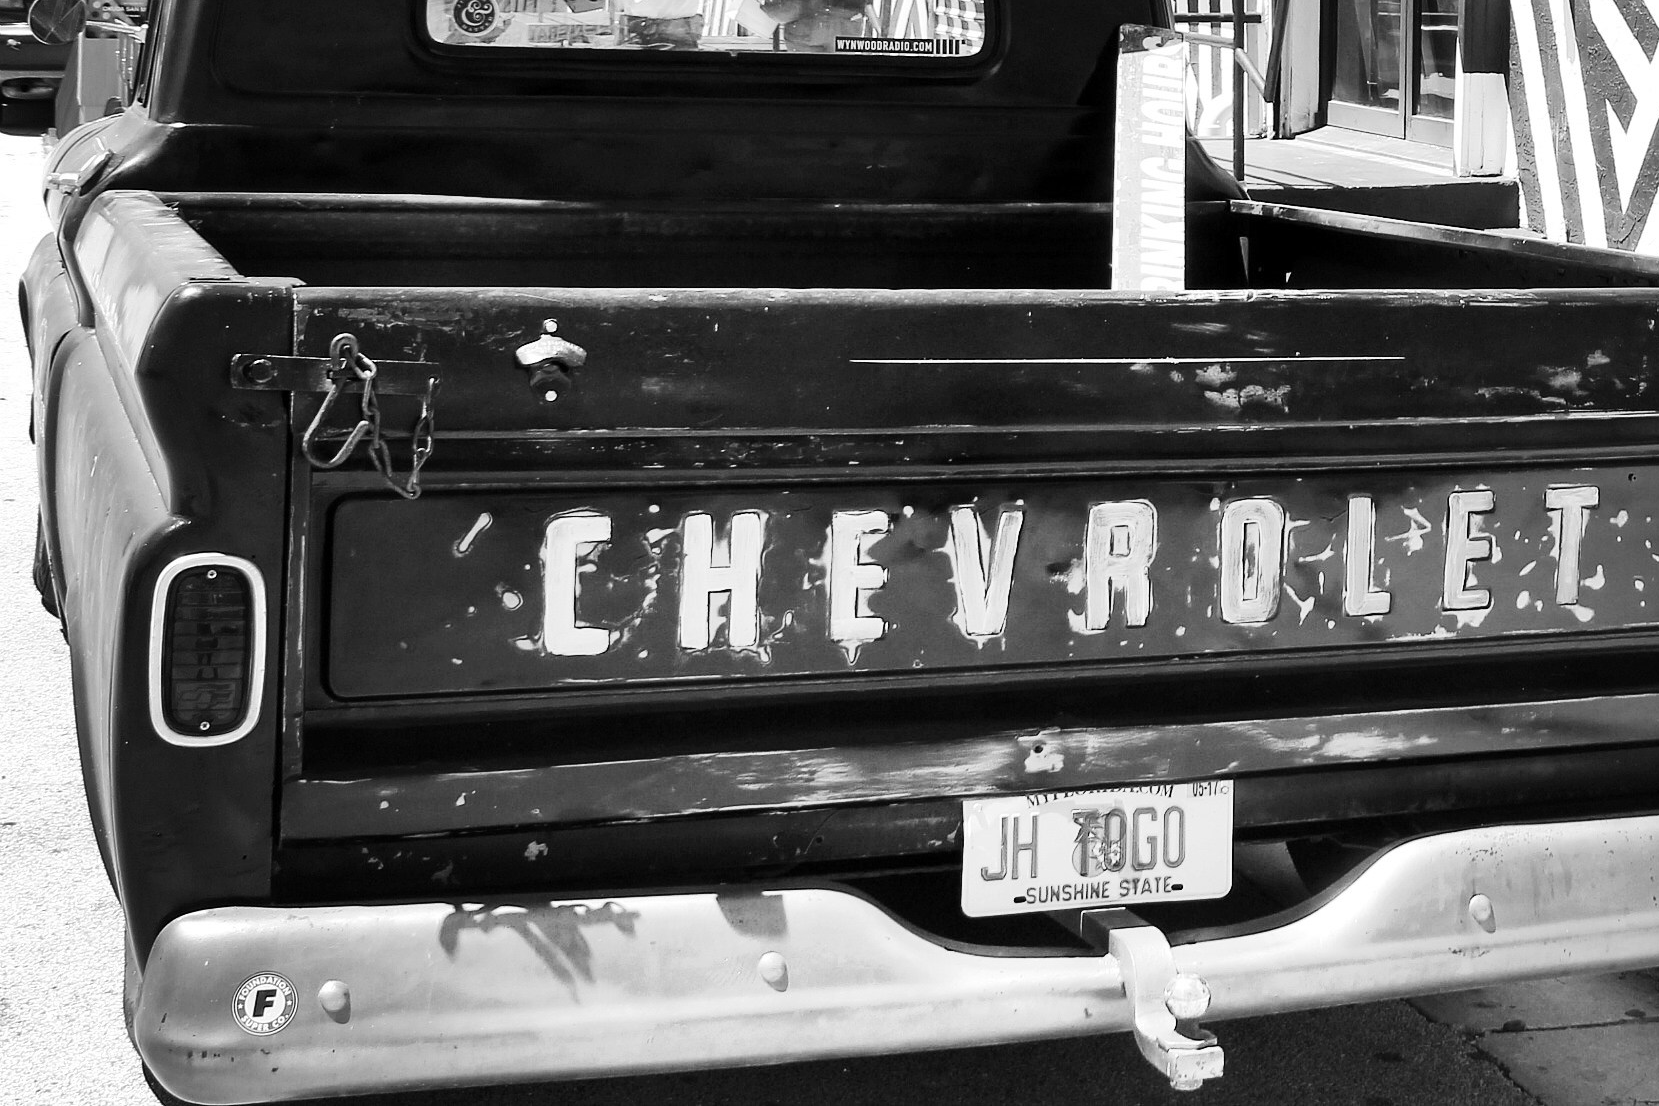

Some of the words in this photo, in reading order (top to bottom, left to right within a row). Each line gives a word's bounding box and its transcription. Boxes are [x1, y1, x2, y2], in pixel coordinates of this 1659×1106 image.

[461, 0, 493, 26] &
[836, 39, 933, 52] WYNWOODRADIO.COM
[1140, 36, 1185, 144] HOURS
[542, 485, 1600, 656] CHEVROLET
[980, 813, 1040, 882] JH
[1026, 880, 1110, 905] SUNSHINE
[1119, 876, 1172, 898] STATE
[239, 976, 292, 1001] FOUNDATION
[252, 988, 277, 1018] F
[241, 1014, 269, 1031] SUPER
[272, 1014, 289, 1027] CO.
